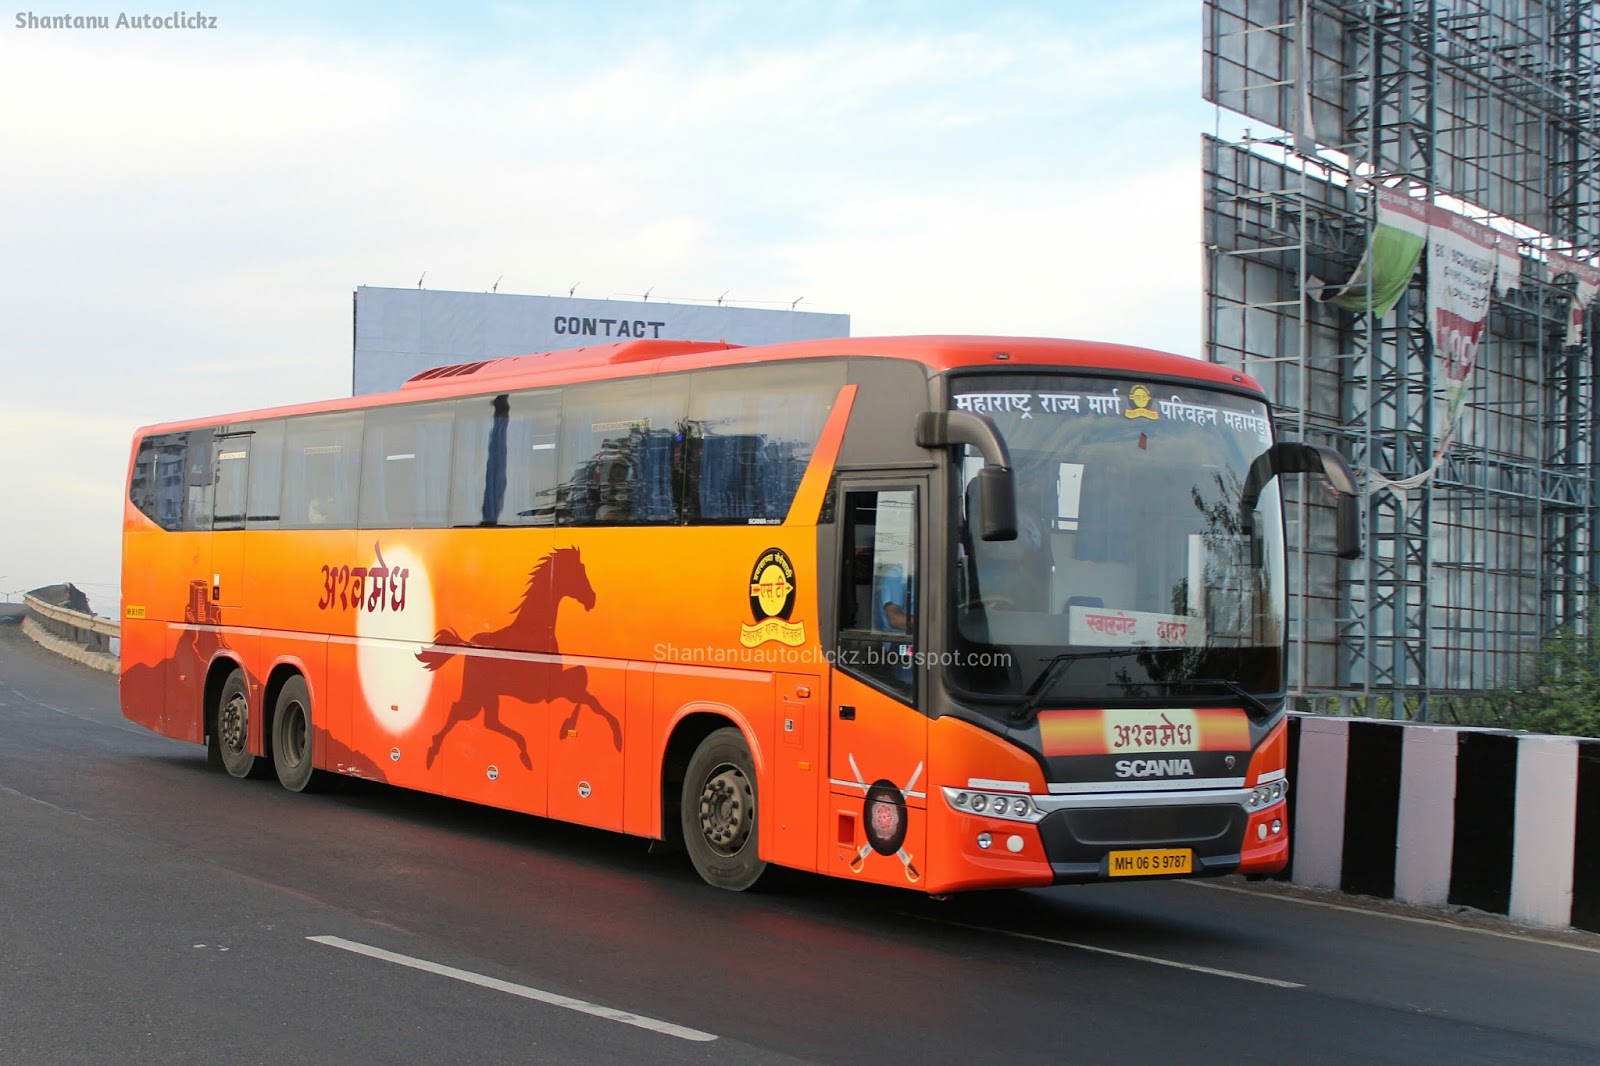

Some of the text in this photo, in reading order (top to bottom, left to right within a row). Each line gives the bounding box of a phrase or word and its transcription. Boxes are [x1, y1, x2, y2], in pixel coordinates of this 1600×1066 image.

[554, 315, 665, 339] CONTACT
[953, 388, 1271, 436] महाराष्ट्र राज्य मार्ग परिवहन महामंड
[1115, 759, 1194, 778] SCANIA
[1115, 855, 1187, 870] MH 06 S 9787
